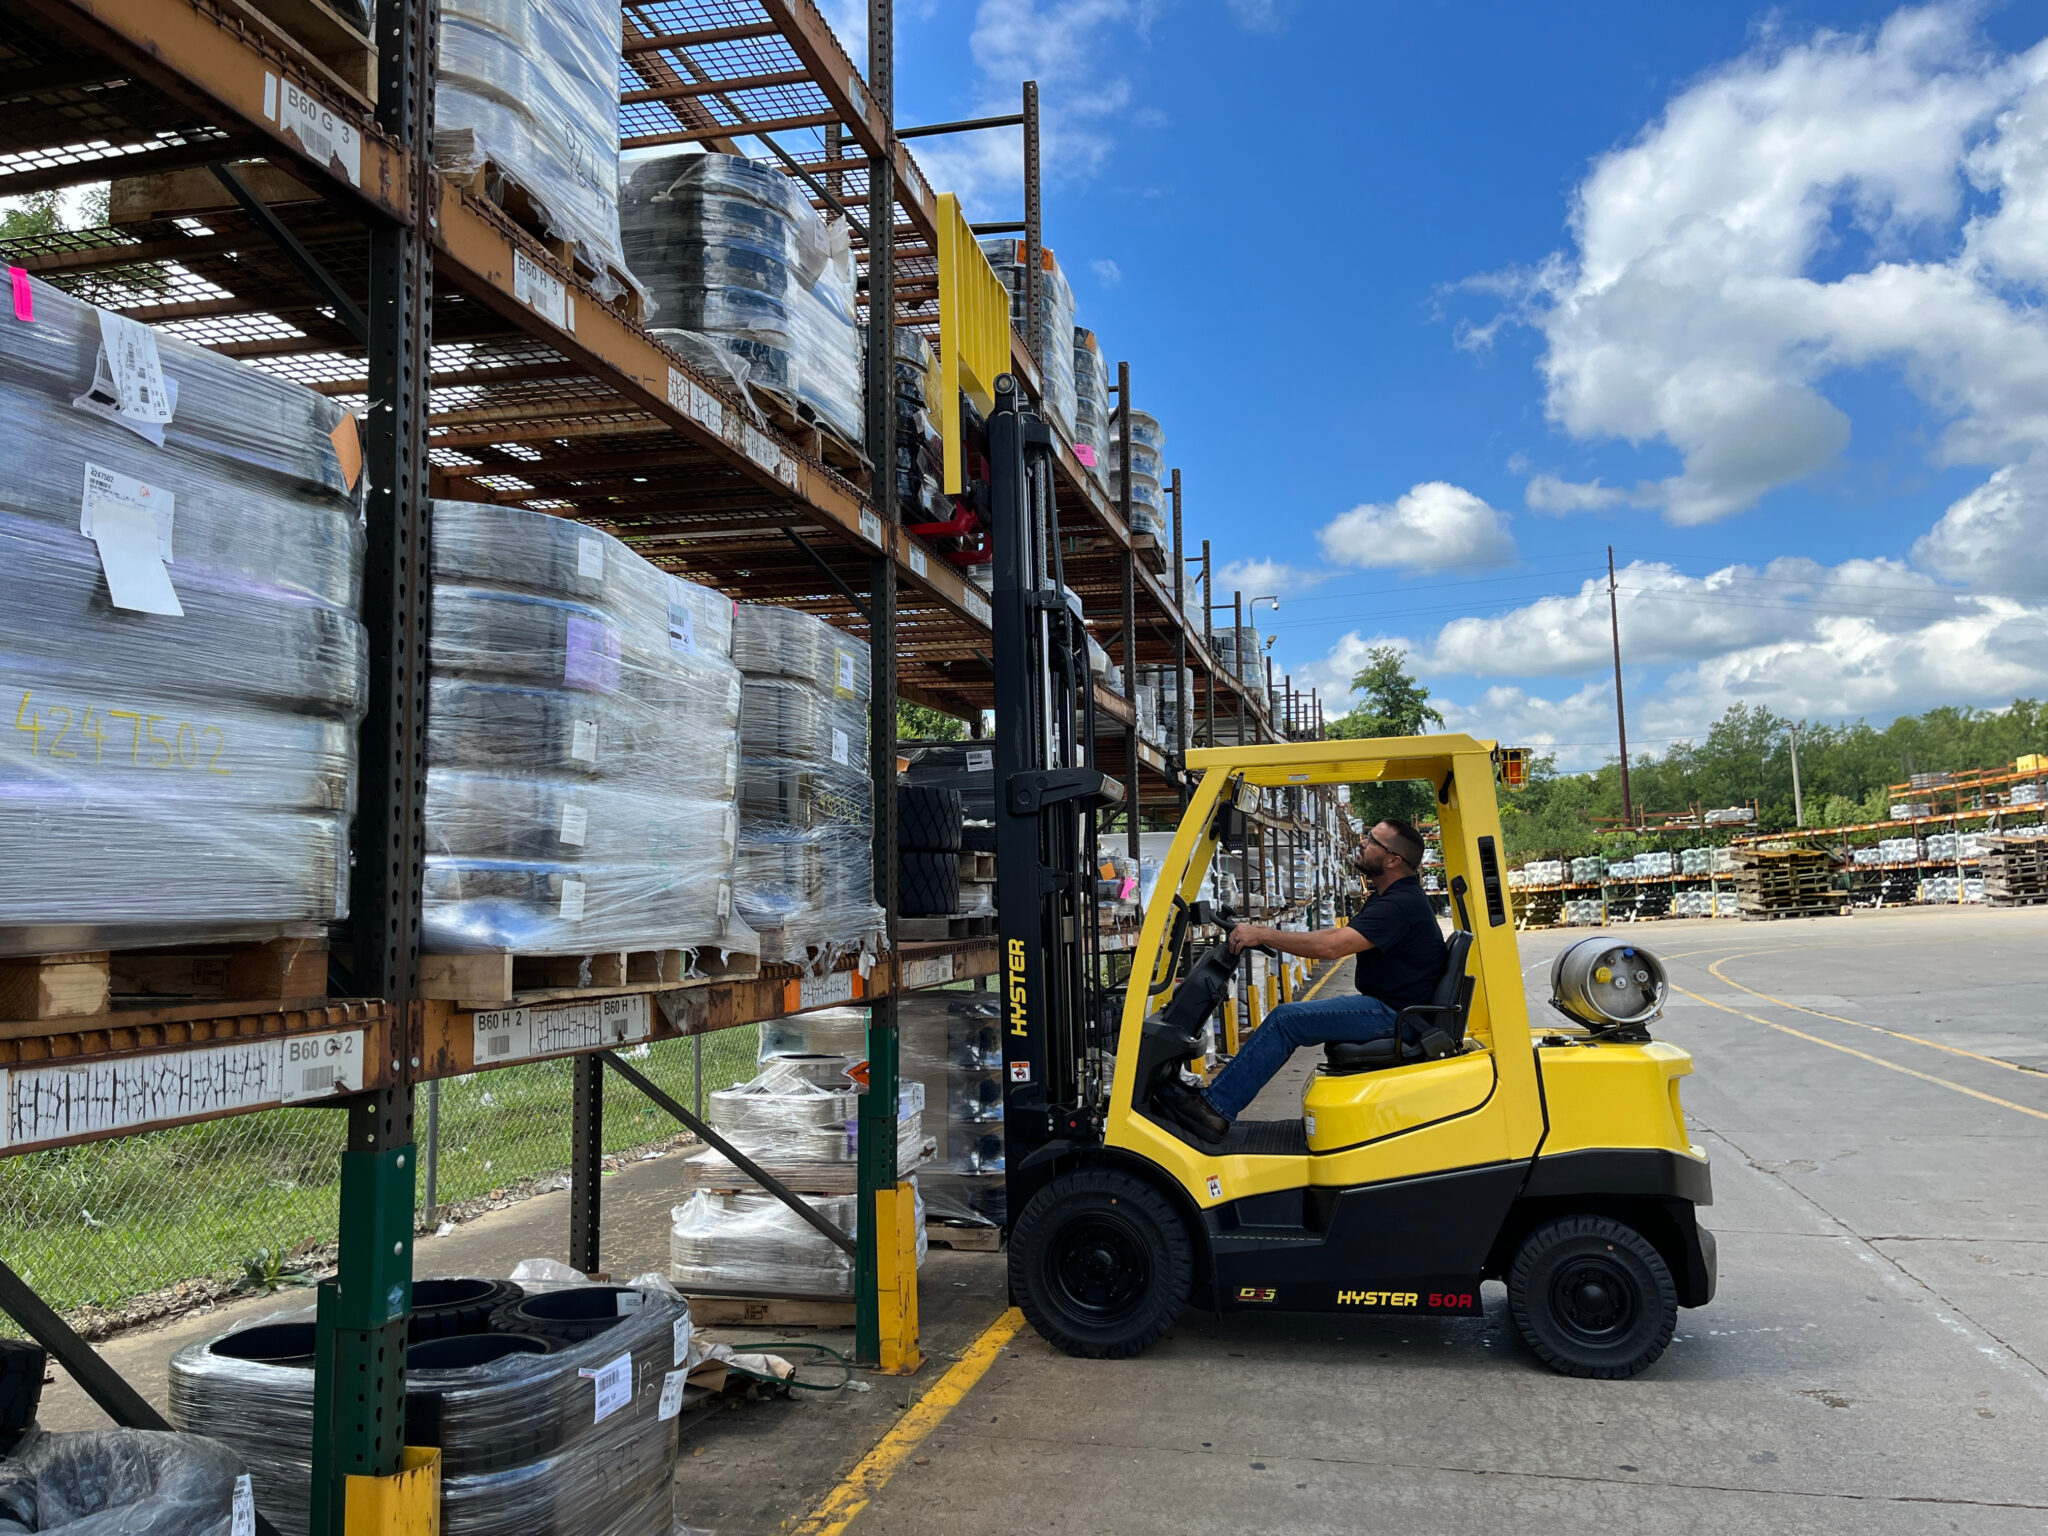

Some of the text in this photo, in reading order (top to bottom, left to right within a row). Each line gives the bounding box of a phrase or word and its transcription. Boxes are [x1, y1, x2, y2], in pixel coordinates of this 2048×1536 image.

[288, 86, 350, 144] B60 G 3
[518, 256, 558, 296] B60 H 3
[90, 468, 114, 483] 4247502
[15, 690, 232, 775] 4247502
[1008, 938, 1027, 1037] HYSTER
[604, 999, 637, 1015] B60 H 1
[478, 1011, 522, 1031] B60 H 2
[289, 1040, 319, 1061] B60
[344, 1036, 353, 1054] 2
[1337, 1290, 1473, 1309] HYSTER 50A
